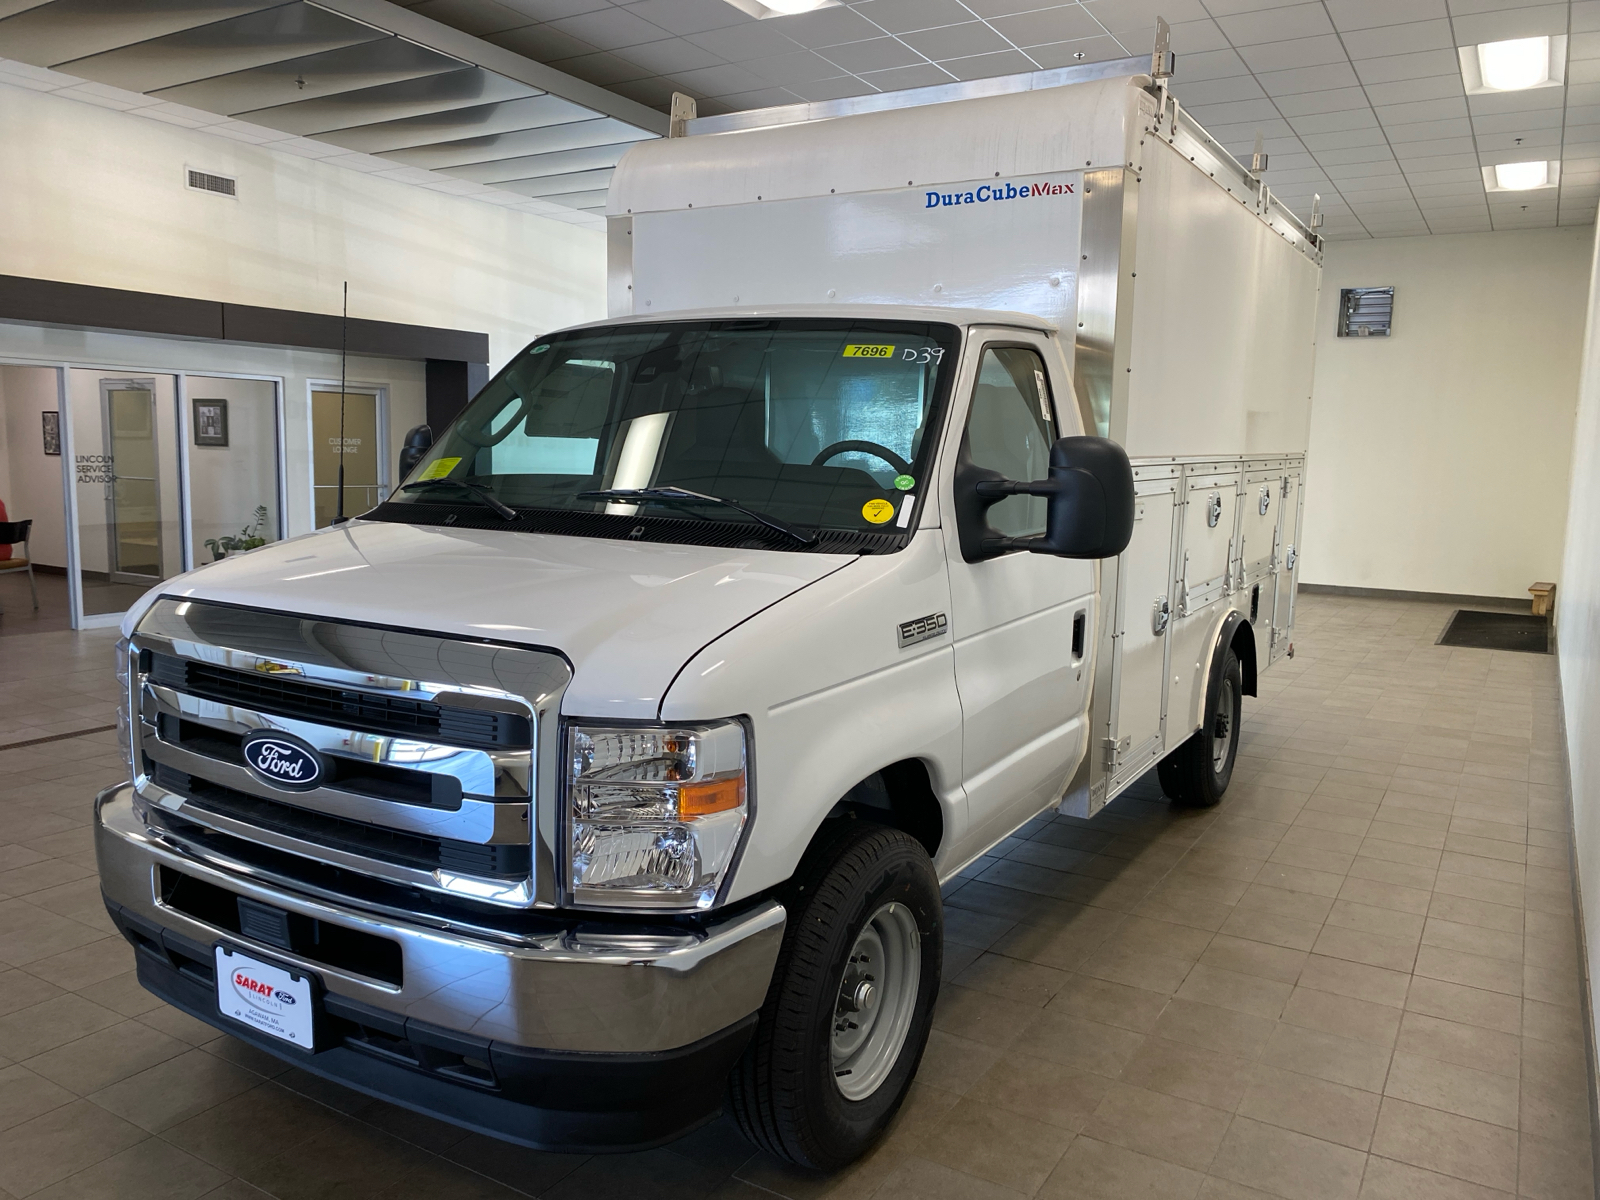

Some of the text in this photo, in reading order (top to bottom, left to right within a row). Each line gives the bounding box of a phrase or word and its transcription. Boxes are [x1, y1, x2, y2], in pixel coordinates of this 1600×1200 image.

[925, 182, 1074, 208] DuraCubeMax
[852, 346, 889, 357] 7696
[902, 347, 945, 365] D39
[328, 437, 362, 446] CUSOMER
[75, 455, 115, 464] LINCOLN
[76, 464, 112, 473] SERVICE
[77, 474, 117, 484] ADVISOR
[258, 743, 303, 778] Ford
[235, 974, 274, 997] SARAT
[252, 994, 278, 1007] LINCOLN
[278, 992, 294, 1004] Ford
